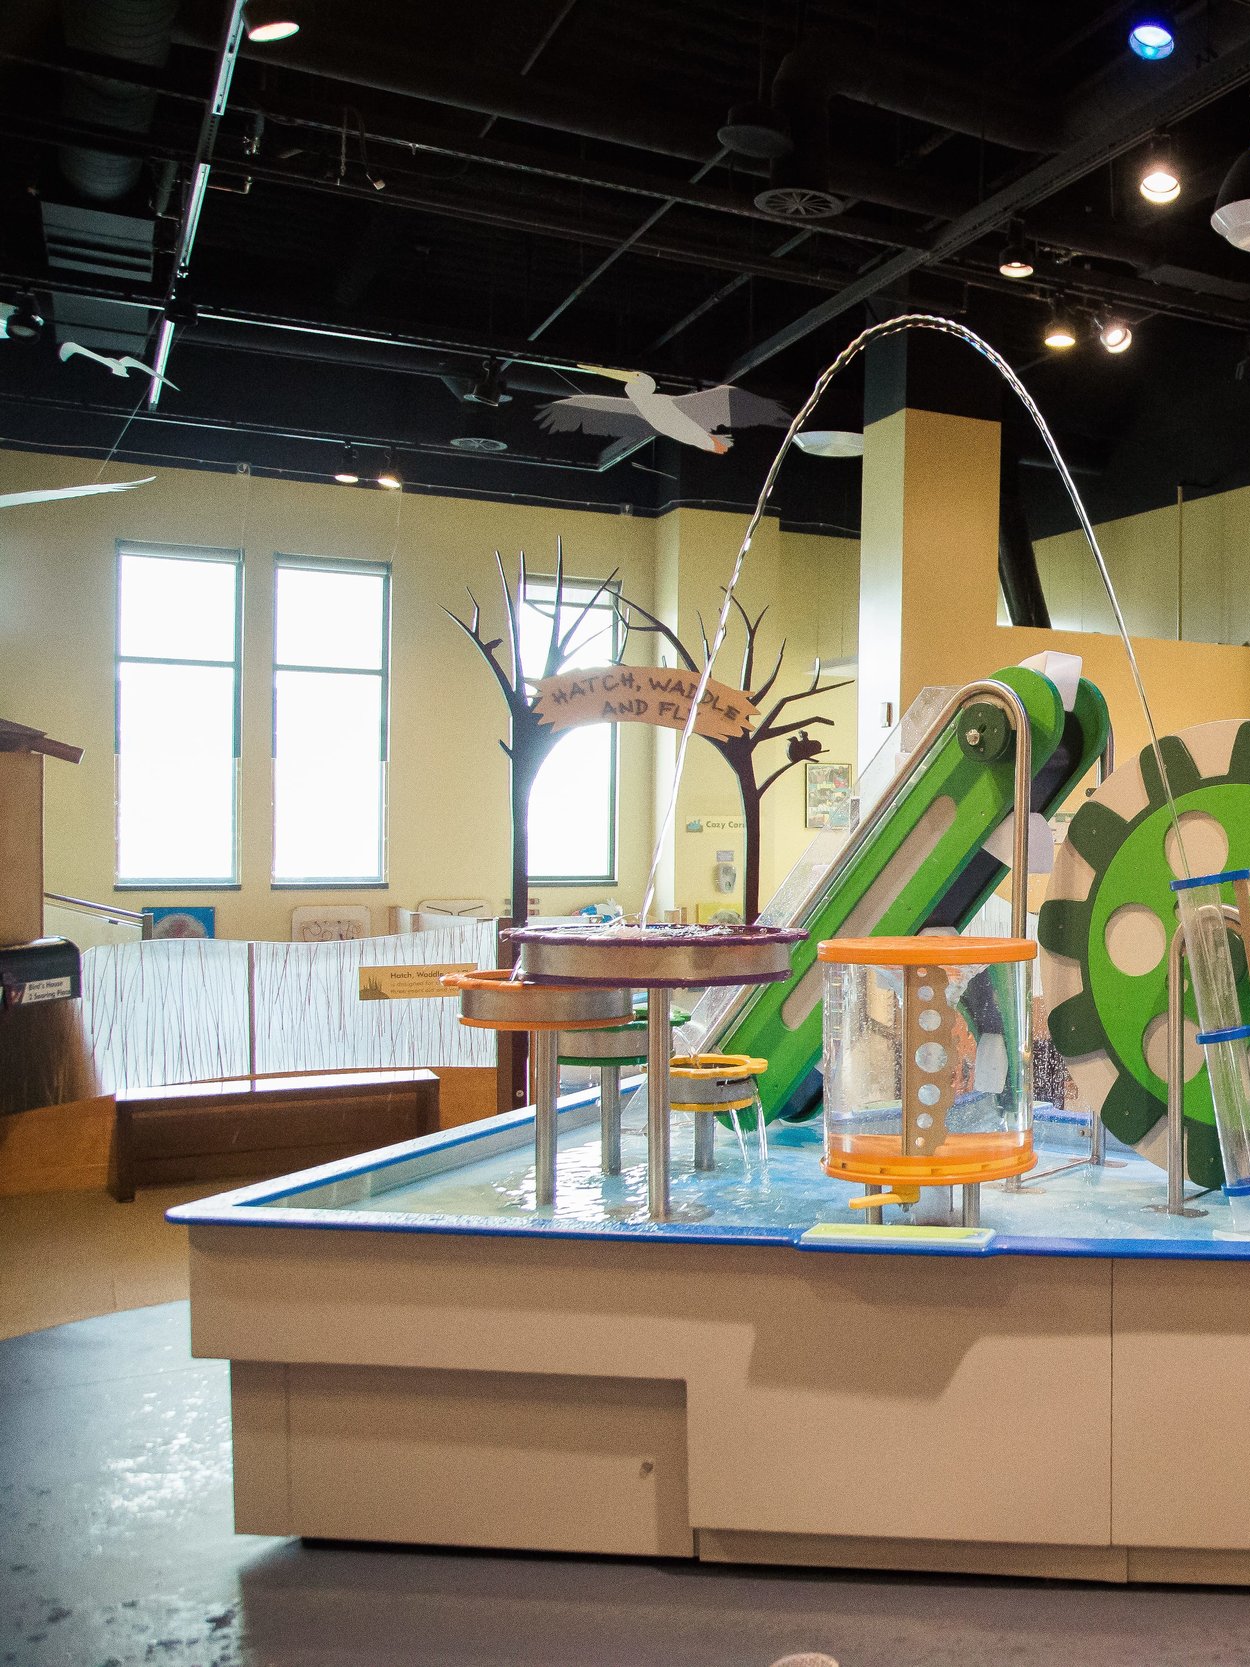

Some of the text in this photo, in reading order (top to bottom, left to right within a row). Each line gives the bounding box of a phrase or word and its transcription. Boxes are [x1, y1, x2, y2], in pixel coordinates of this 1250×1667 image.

[552, 672, 741, 722] HATCH, WADDLE
[601, 698, 701, 721] AND FL
[706, 820, 745, 830] Cozy Cor
[390, 972, 415, 980] Hatch,
[416, 971, 445, 979] Waddle
